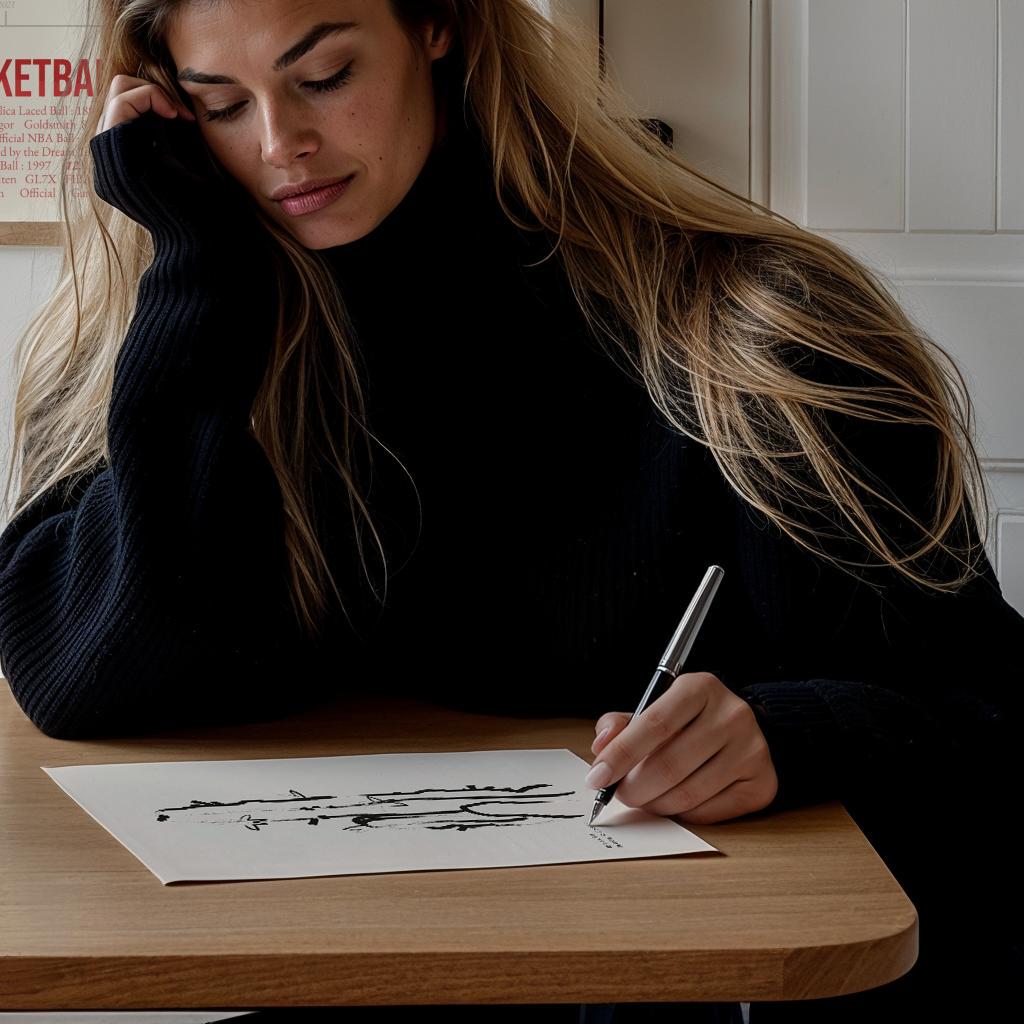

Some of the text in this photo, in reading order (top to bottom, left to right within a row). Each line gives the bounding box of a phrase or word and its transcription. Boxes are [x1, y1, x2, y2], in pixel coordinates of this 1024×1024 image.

[19, 106, 47, 116] Laced
[27, 133, 53, 144] NBA
[9, 147, 20, 160] by
[23, 147, 39, 157] the
[0, 160, 19, 171] Ball
[27, 160, 51, 171] 1997
[24, 174, 57, 185] GL7X
[19, 188, 56, 198] Official
